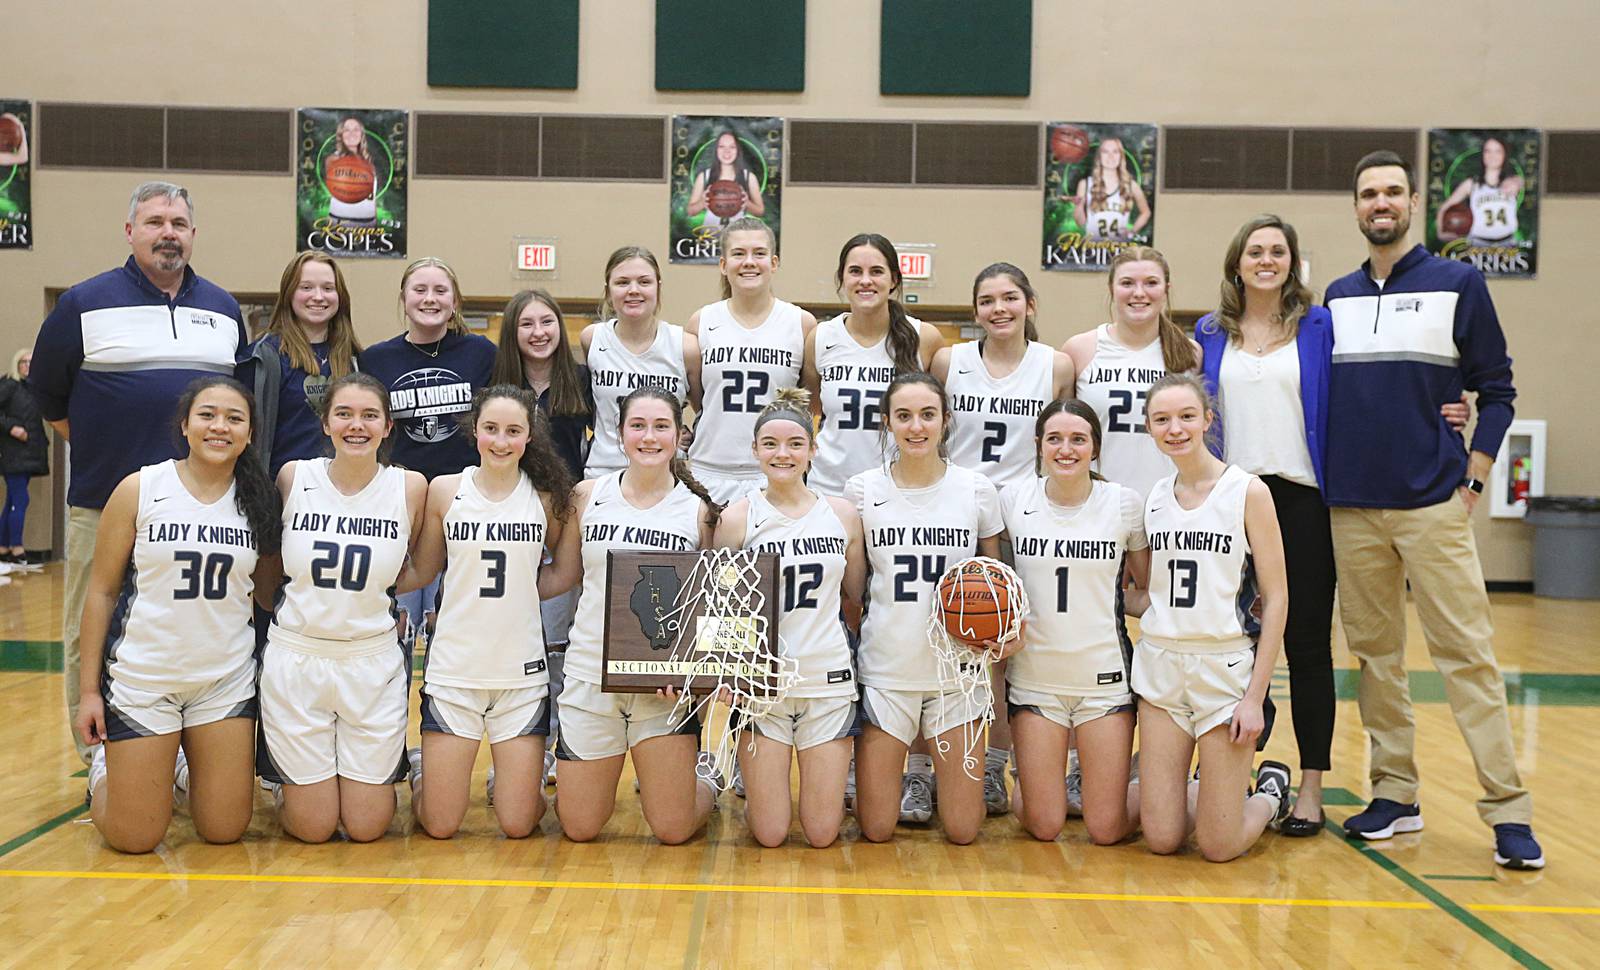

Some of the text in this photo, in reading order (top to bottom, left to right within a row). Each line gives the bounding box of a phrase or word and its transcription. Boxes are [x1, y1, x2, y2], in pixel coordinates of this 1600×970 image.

[1098, 219, 1119, 238] 24
[1484, 208, 1507, 227] 34
[0, 223, 27, 244] ER
[307, 231, 394, 252] COPES
[525, 247, 550, 267] EXIT
[901, 255, 925, 275] EXIT
[704, 346, 792, 368] LADY KNIGHTS
[594, 369, 679, 393] LADY KNIGHTS
[823, 365, 896, 383] LADY KNIGH
[1088, 367, 1167, 385] LADY KNIGH
[389, 382, 472, 411] ADY KNIGHTS
[722, 370, 769, 413] 22
[838, 388, 888, 431] 32
[953, 394, 1044, 417] LADY KNIGHTS
[981, 421, 1007, 463] 2
[149, 523, 257, 551] LADY KNIGHTS
[292, 512, 399, 540] LADY KNIGHTS
[447, 522, 543, 543] LADY KNIGHTS
[585, 524, 688, 551] LADY KNIGHTS
[871, 527, 970, 548] LADY KNIGHTS
[750, 537, 845, 557] ADY KNIGHTS
[1016, 536, 1116, 560] LADY KNIGHTS
[1150, 531, 1232, 554] ADY KNIGHTS
[173, 550, 234, 600] 30
[311, 541, 372, 592] 20
[479, 550, 507, 599] 3
[893, 554, 948, 602] 24
[782, 562, 824, 613] 12
[1055, 566, 1069, 613] 1
[1167, 559, 1198, 608] 13
[614, 661, 683, 674] SECTIONAL
